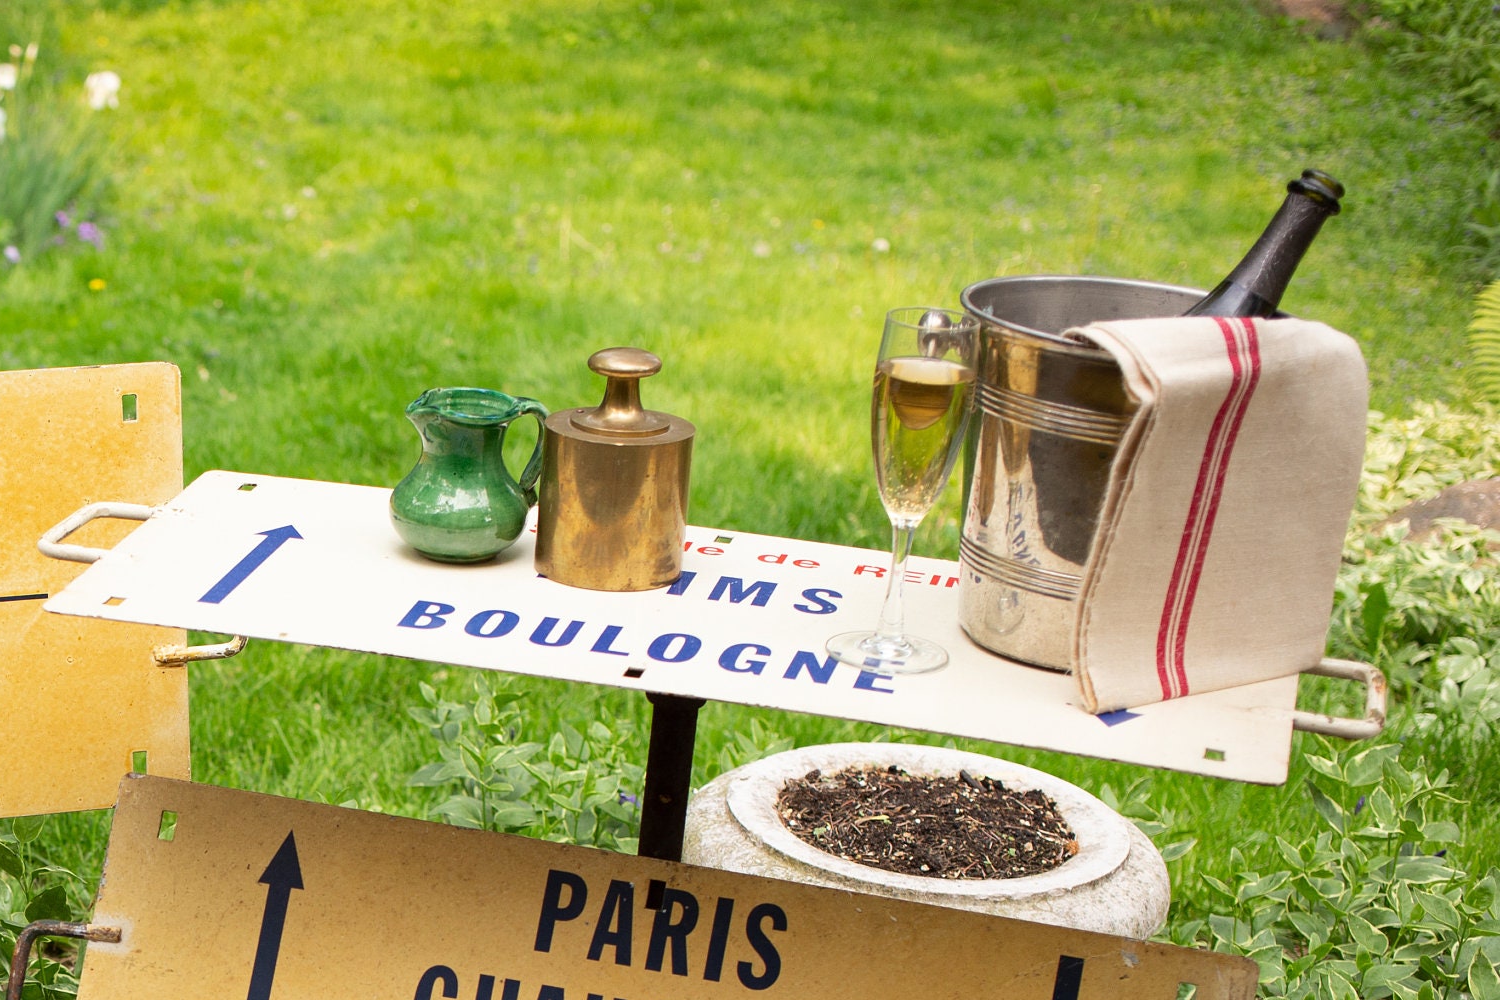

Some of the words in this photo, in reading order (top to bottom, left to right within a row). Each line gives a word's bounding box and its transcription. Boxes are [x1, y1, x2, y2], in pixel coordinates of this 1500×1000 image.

[666, 570, 843, 615] IMS
[757, 553, 820, 569] de
[853, 564, 959, 588] REI
[396, 599, 905, 694] BOULOGNE
[533, 869, 788, 991] PARIS
